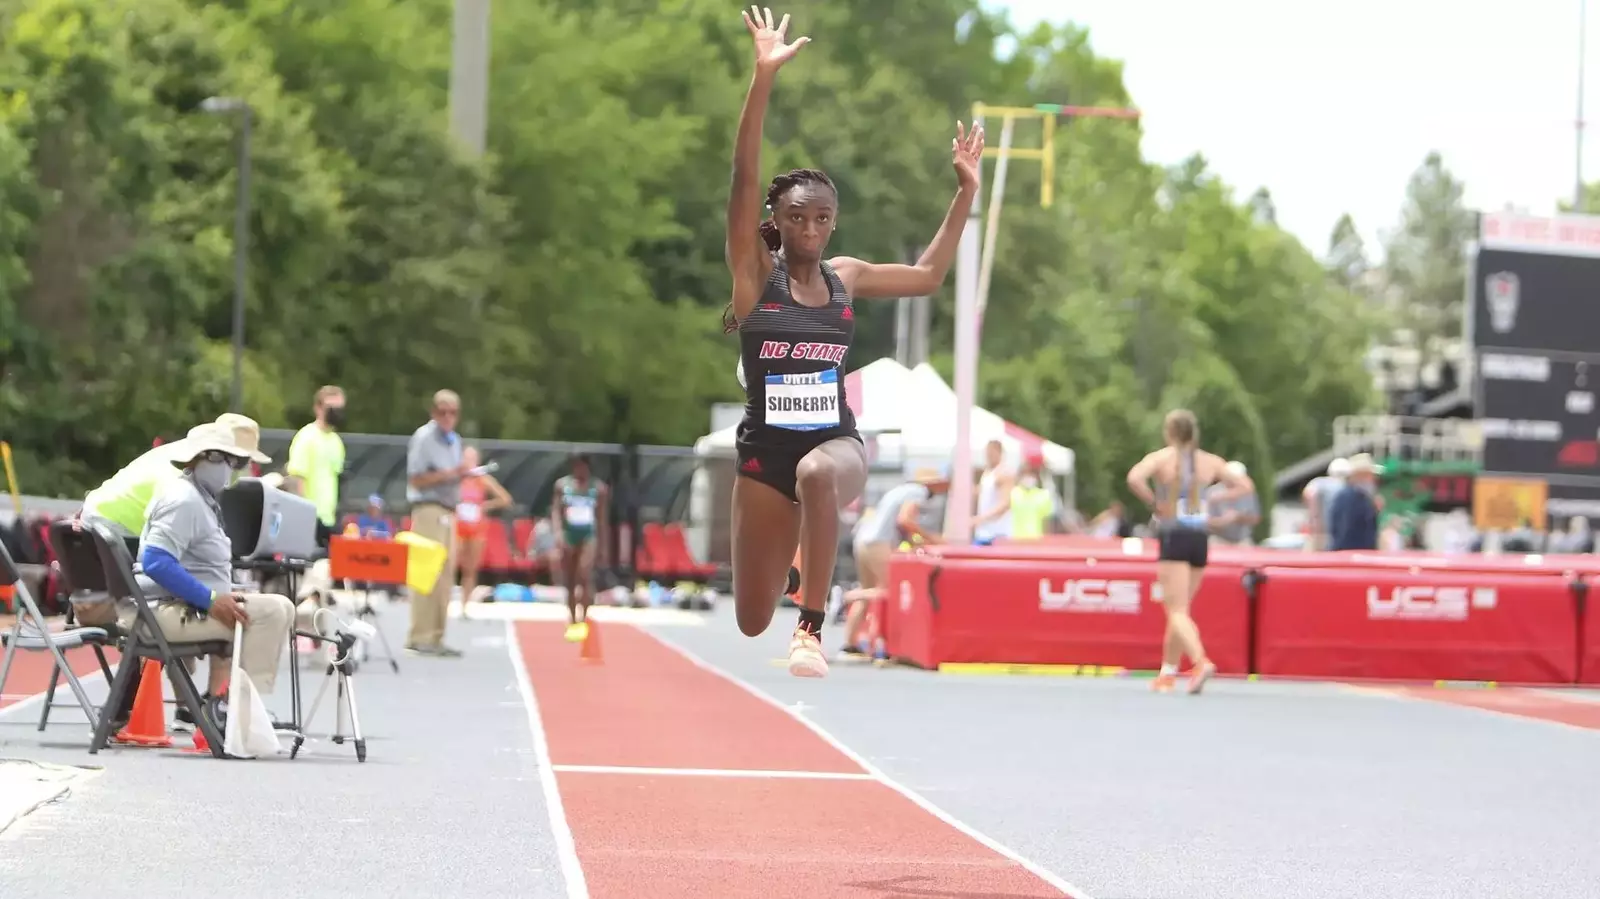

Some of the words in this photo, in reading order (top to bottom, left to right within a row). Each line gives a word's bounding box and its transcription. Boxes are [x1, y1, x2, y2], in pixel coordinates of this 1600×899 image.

[759, 341, 790, 359] NC
[791, 342, 848, 362] STATE
[768, 395, 836, 412] SIDBERRY
[1039, 578, 1141, 605] UCS
[1367, 585, 1468, 612] UCS
